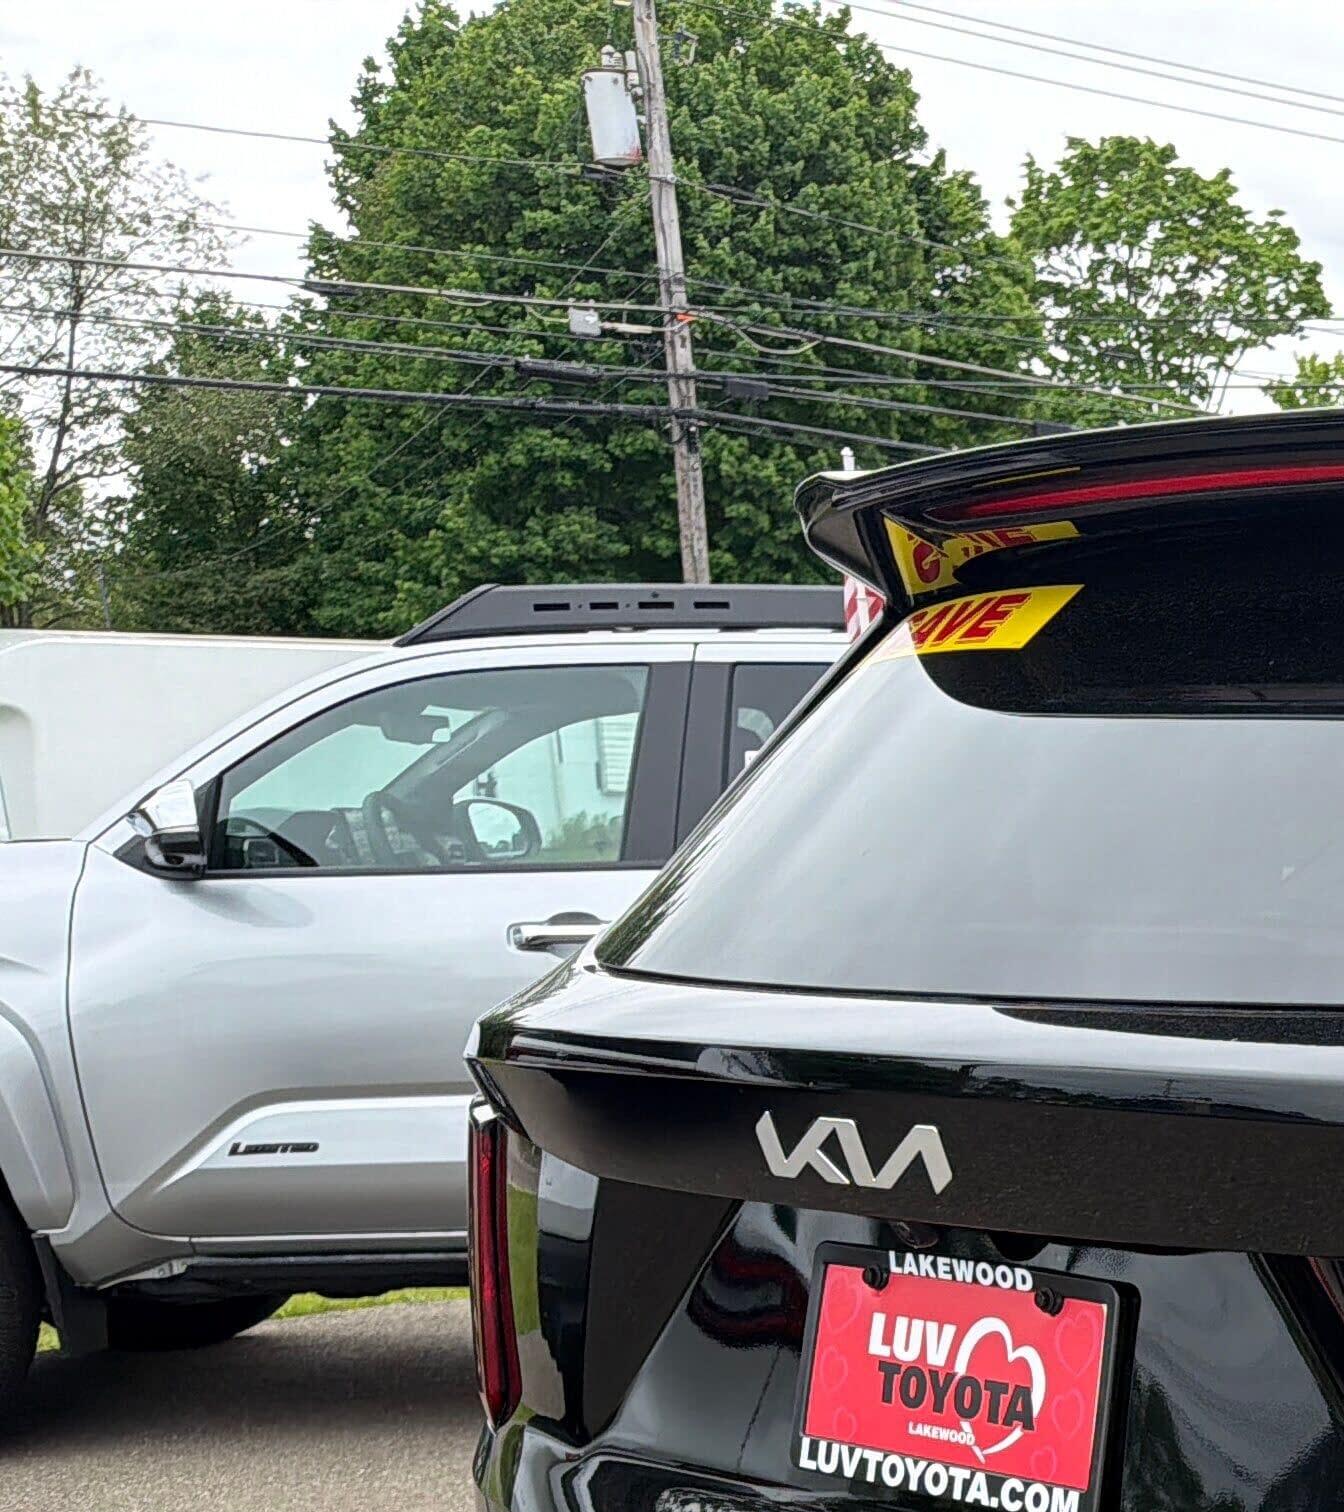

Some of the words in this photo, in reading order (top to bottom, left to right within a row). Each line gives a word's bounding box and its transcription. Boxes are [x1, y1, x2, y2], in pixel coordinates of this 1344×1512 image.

[755, 1110, 953, 1195] KIA
[889, 1250, 1034, 1292] LAKEWOOD
[868, 1312, 957, 1366] LUV
[878, 1361, 1036, 1431] TOYOTA
[908, 1421, 976, 1447] LAKEWOOD
